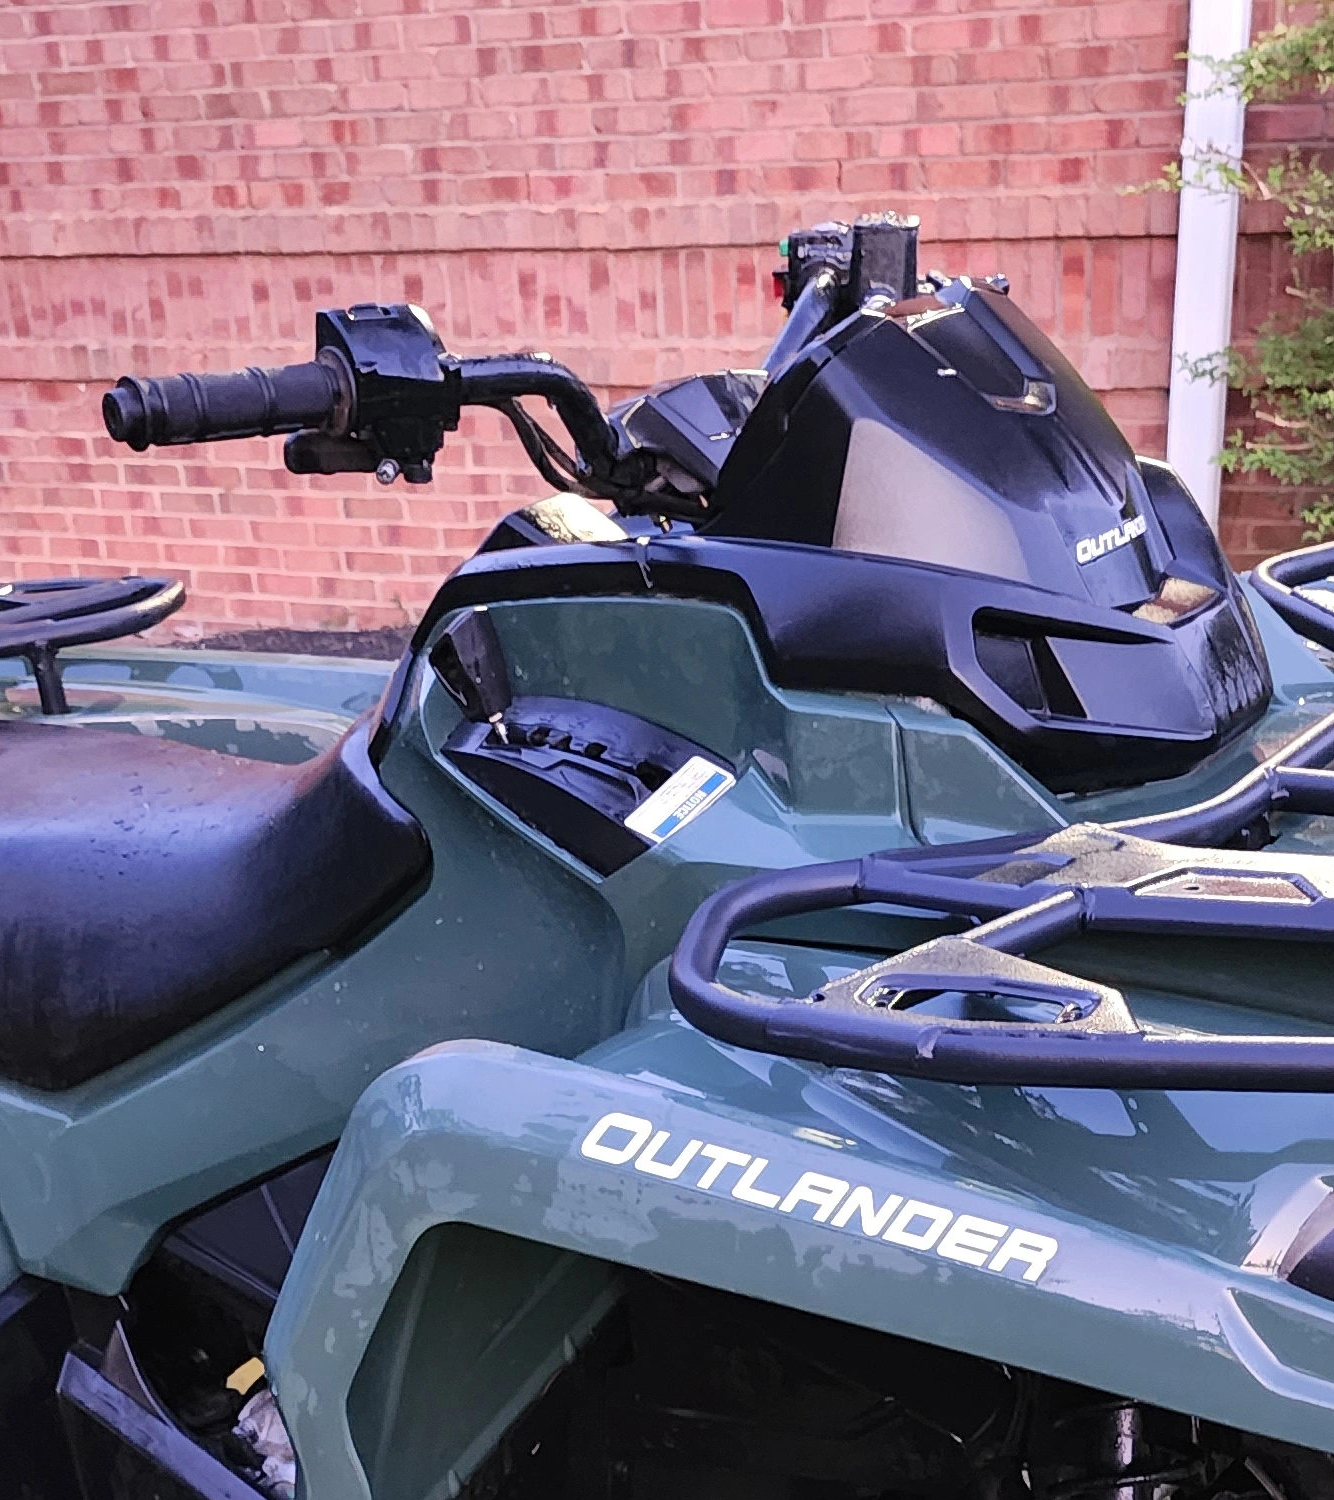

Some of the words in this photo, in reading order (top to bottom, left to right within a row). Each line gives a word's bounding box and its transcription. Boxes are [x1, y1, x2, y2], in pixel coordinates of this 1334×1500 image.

[1075, 513, 1147, 564] OUTLAND
[671, 789, 709, 821] NOTICE
[580, 1111, 1059, 1283] OUTLANDER
